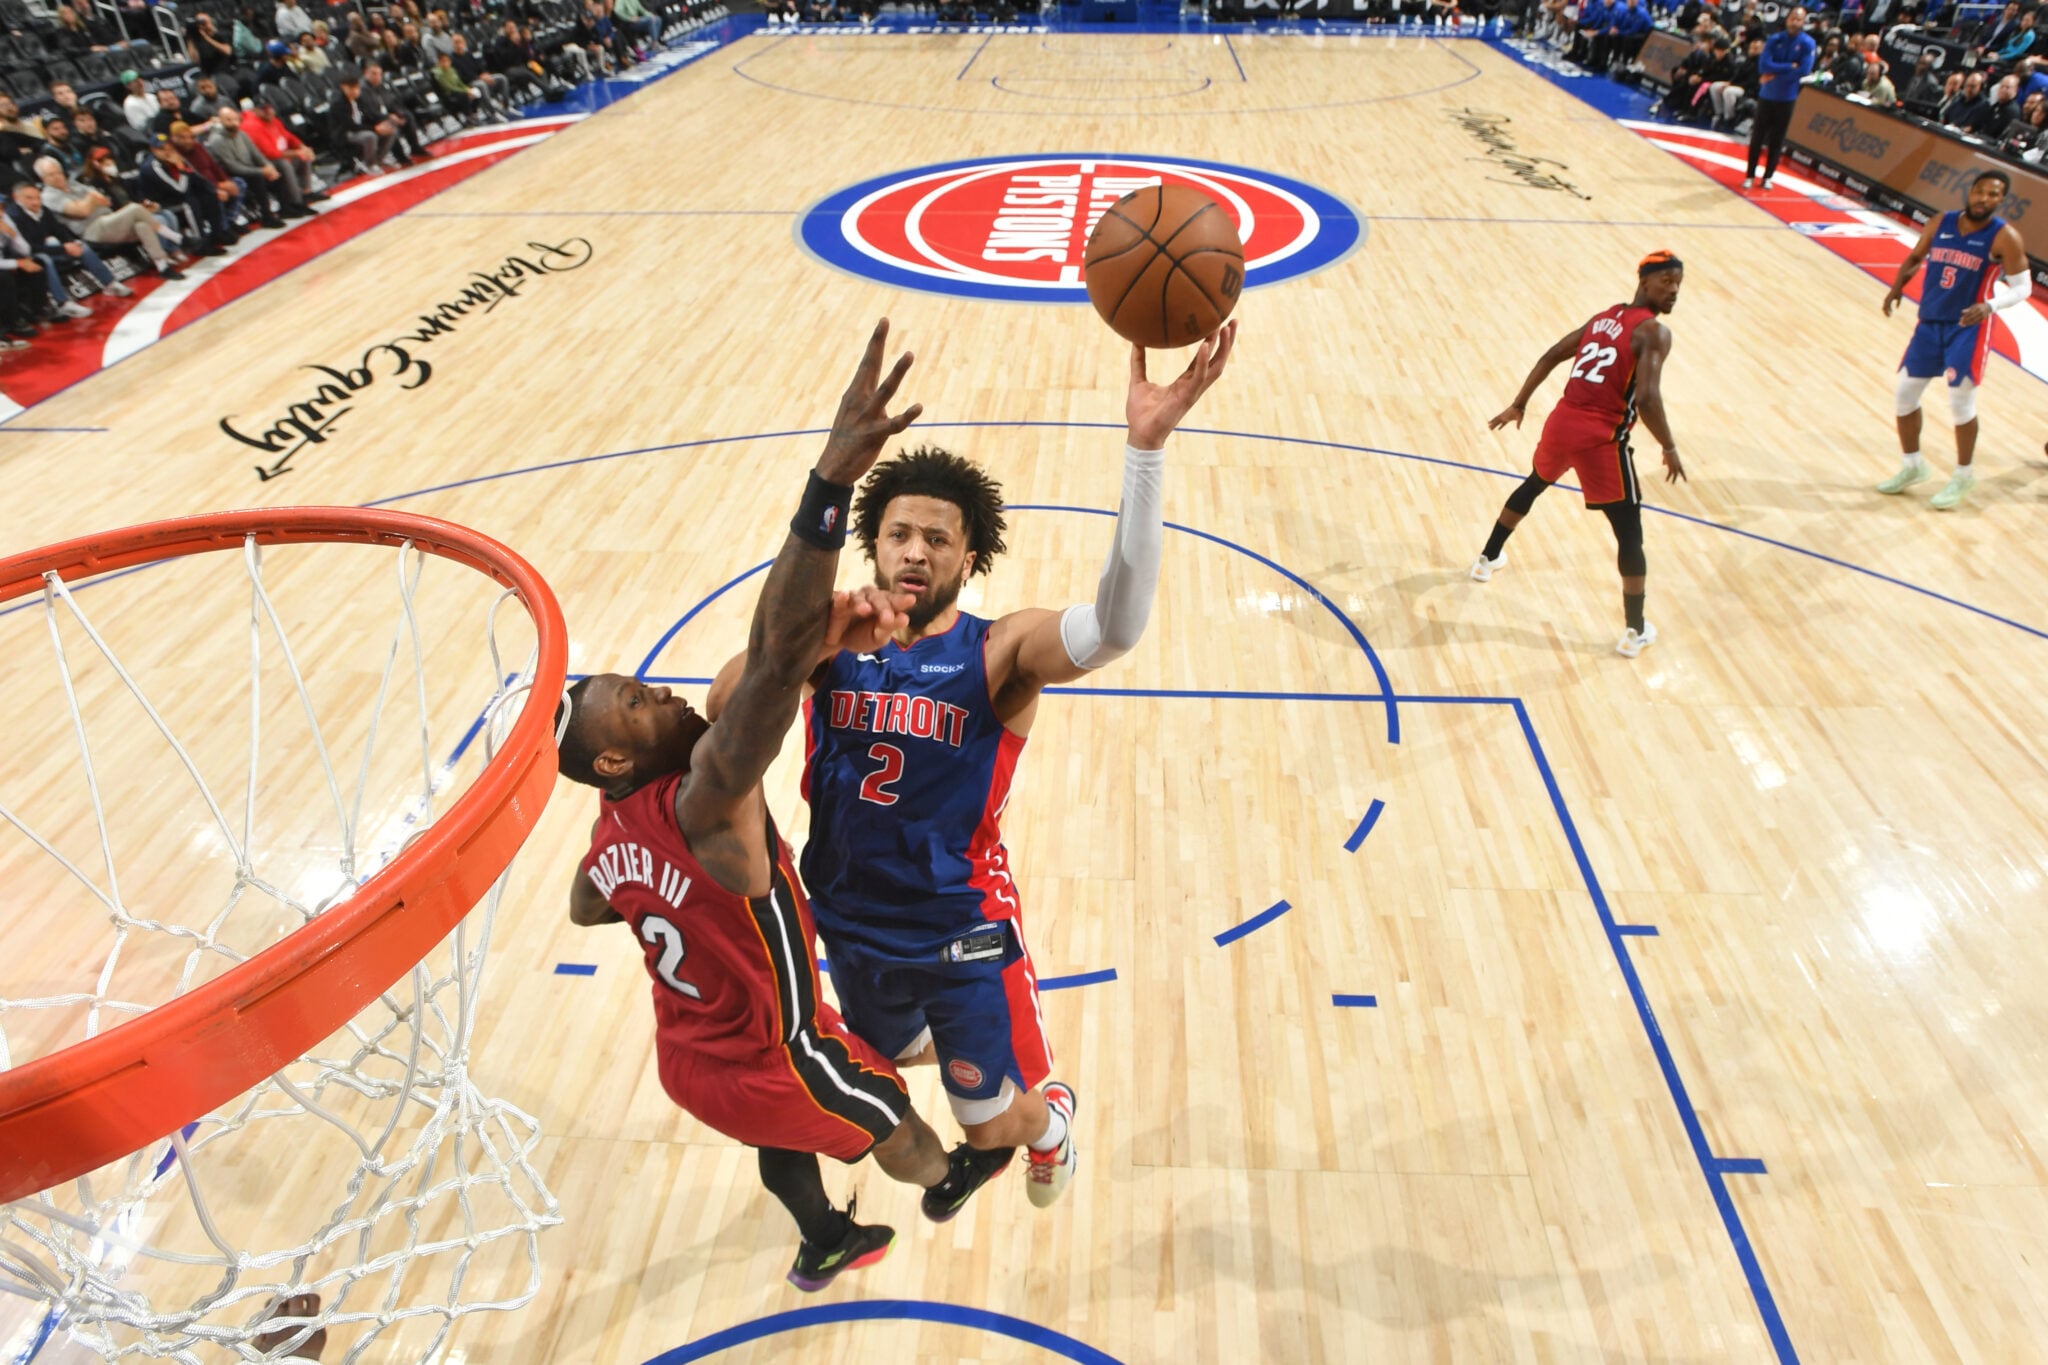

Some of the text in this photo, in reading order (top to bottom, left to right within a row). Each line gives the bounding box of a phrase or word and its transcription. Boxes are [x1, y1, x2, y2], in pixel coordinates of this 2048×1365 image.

[981, 173, 1082, 263] PISTONS
[1930, 246, 1984, 272] DETROIT
[1940, 265, 1958, 289] 5
[218, 237, 593, 482] Platinum Equity
[1570, 341, 1618, 384] 22
[920, 662, 965, 674] StockX
[829, 690, 970, 748] DETROIT
[858, 741, 905, 806] 2
[587, 842, 692, 910] ROZIER III
[639, 914, 703, 1000] 2
